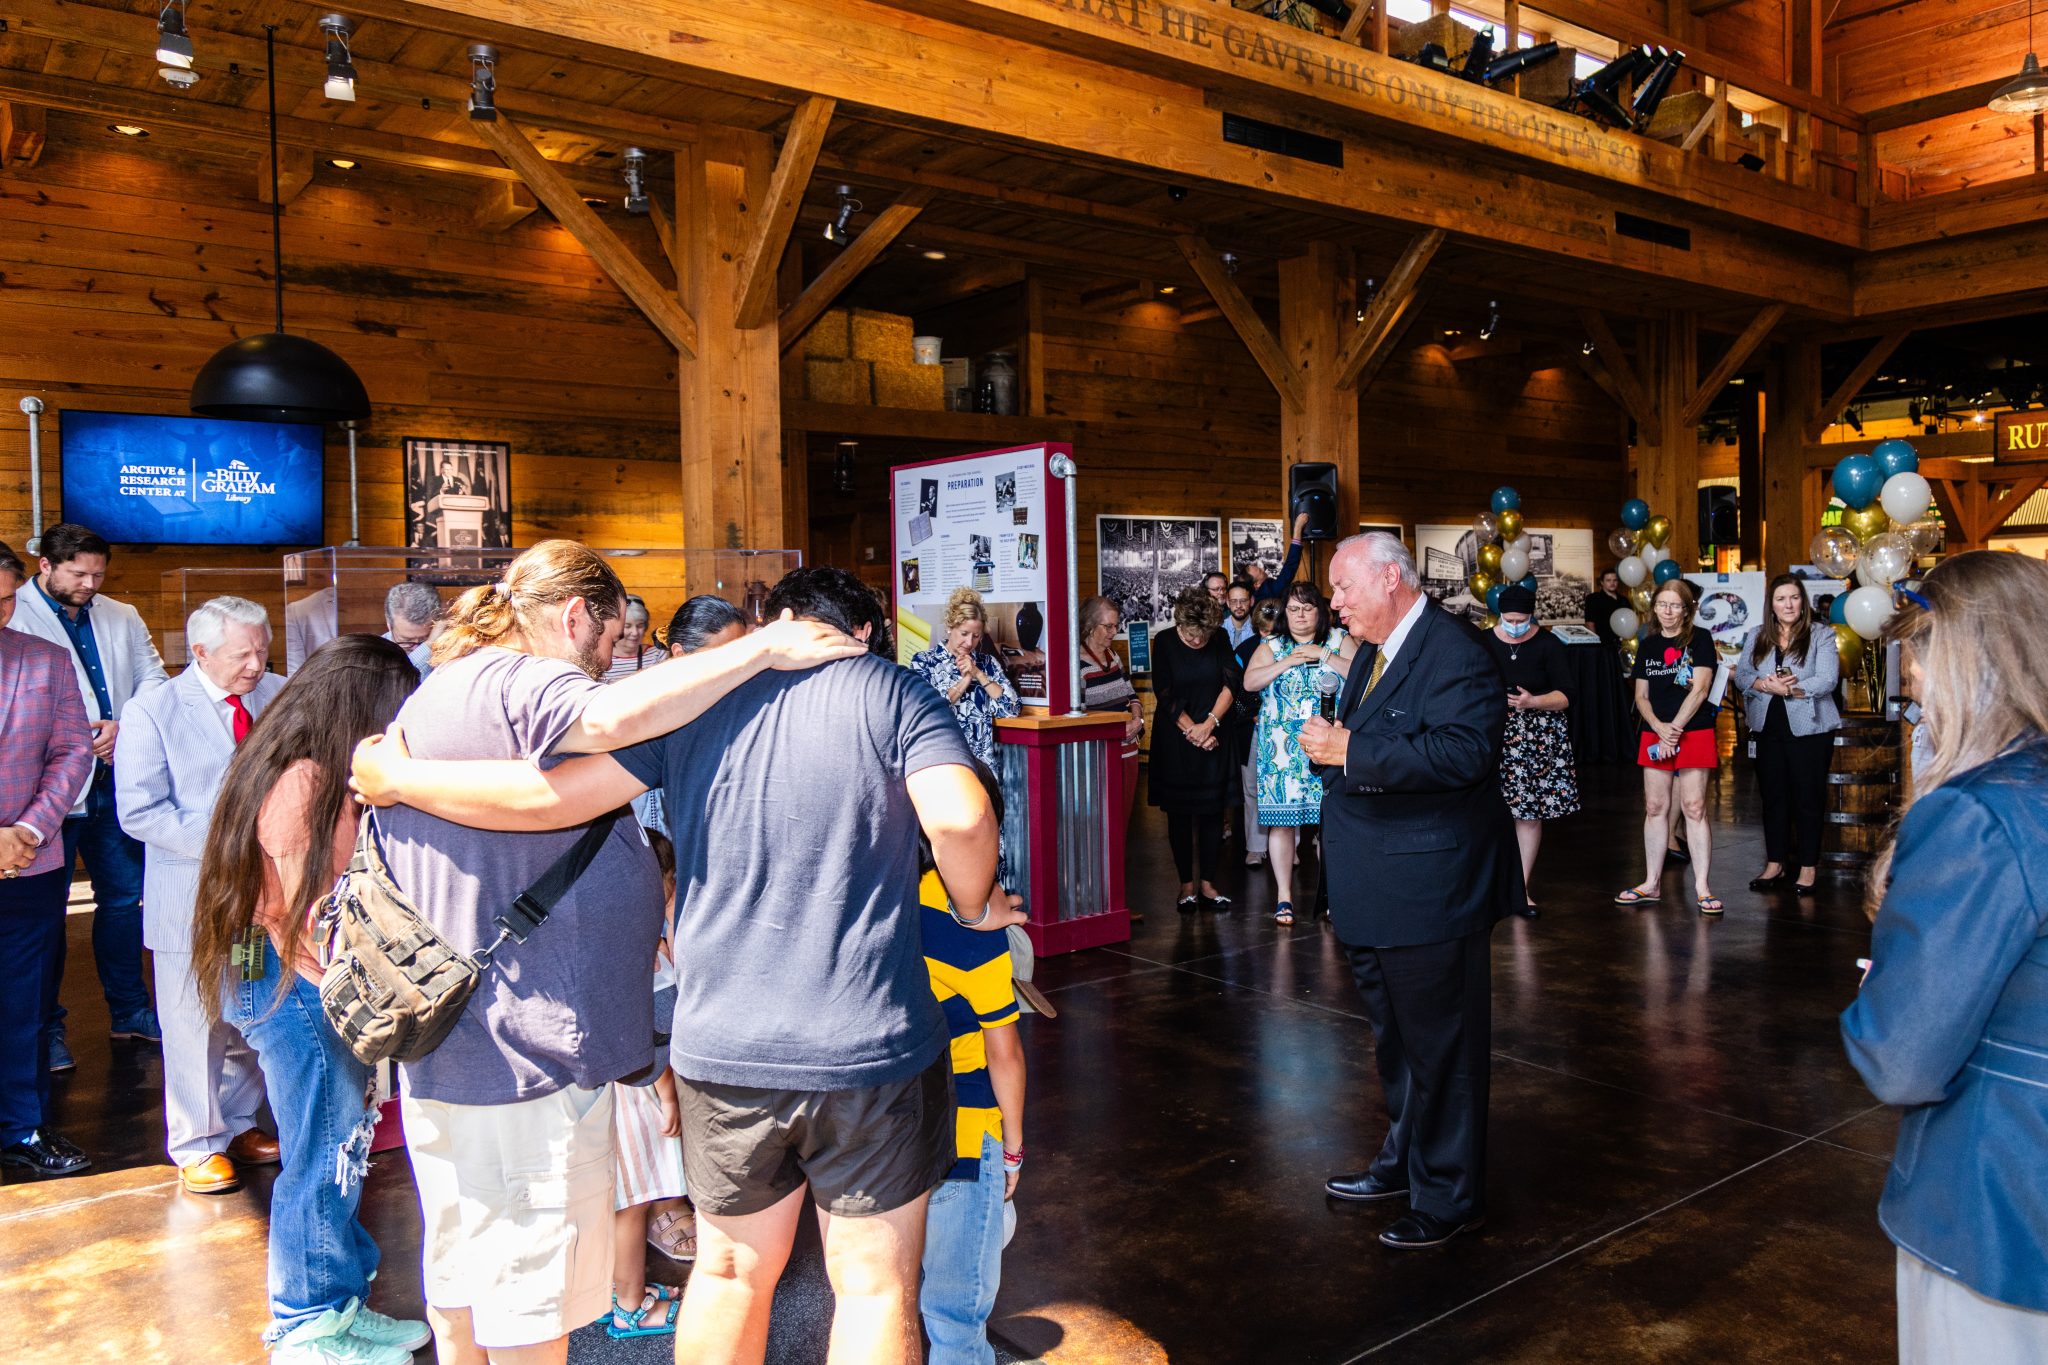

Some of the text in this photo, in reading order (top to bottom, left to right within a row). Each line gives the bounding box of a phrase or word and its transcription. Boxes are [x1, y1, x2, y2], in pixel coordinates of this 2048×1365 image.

[1159, 5, 1212, 49] HE
[1222, 24, 1315, 83] GAVE
[1322, 54, 1377, 97] HIS
[1386, 75, 1462, 121] ONLY
[1469, 98, 1602, 162] BEGOTTEN
[1607, 141, 1655, 176] SON
[120, 465, 186, 476] ARCHIVE &
[215, 468, 261, 484] BILLY
[120, 476, 186, 486] RESEARCH
[201, 479, 276, 494] GRAHAM
[947, 477, 984, 491] PREPARATION
[120, 487, 171, 497] CENTER
[225, 493, 251, 504] Library
[1645, 659, 1662, 667] Live
